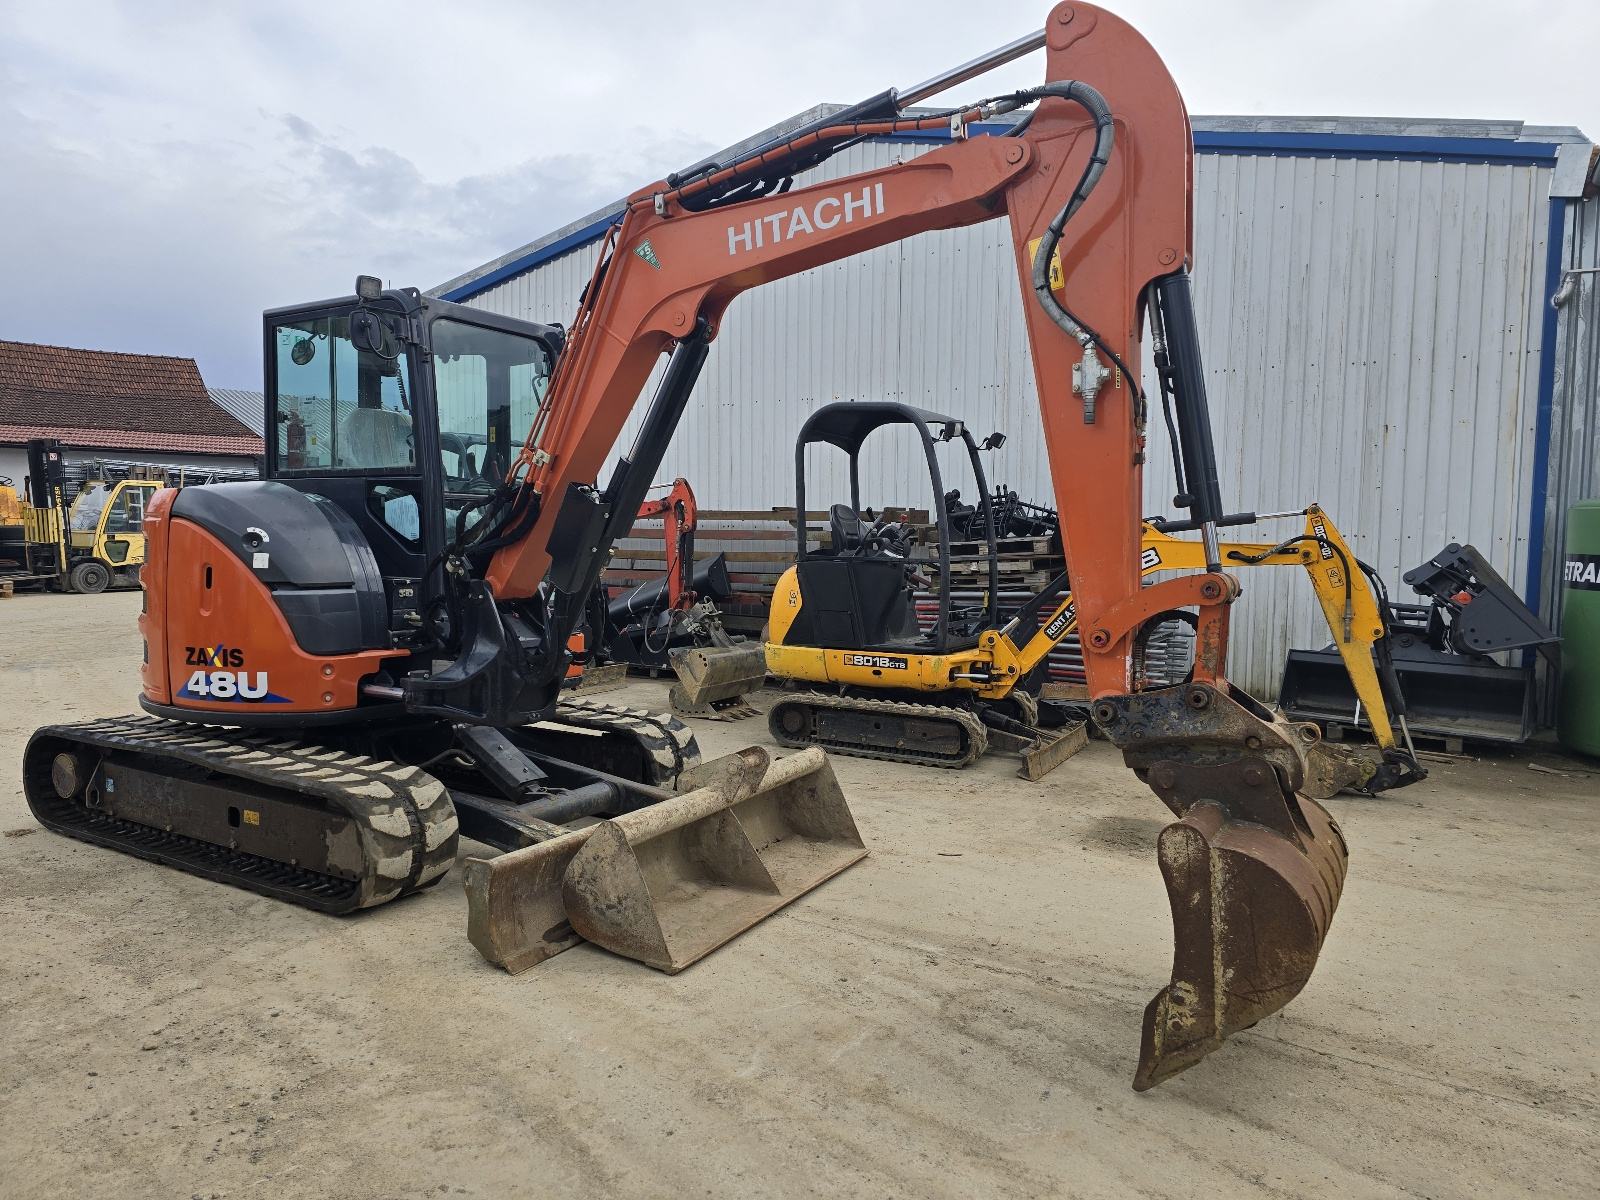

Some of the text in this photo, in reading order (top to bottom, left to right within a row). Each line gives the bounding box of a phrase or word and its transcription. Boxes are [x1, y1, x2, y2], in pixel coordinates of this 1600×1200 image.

[727, 182, 885, 256] HITACHI
[54, 486, 62, 509] YSTER
[1564, 560, 1600, 584] ETRA
[1046, 615, 1067, 636] RENT
[1064, 610, 1072, 618] A
[185, 644, 244, 668] ZAXIS
[187, 670, 269, 700] 48U
